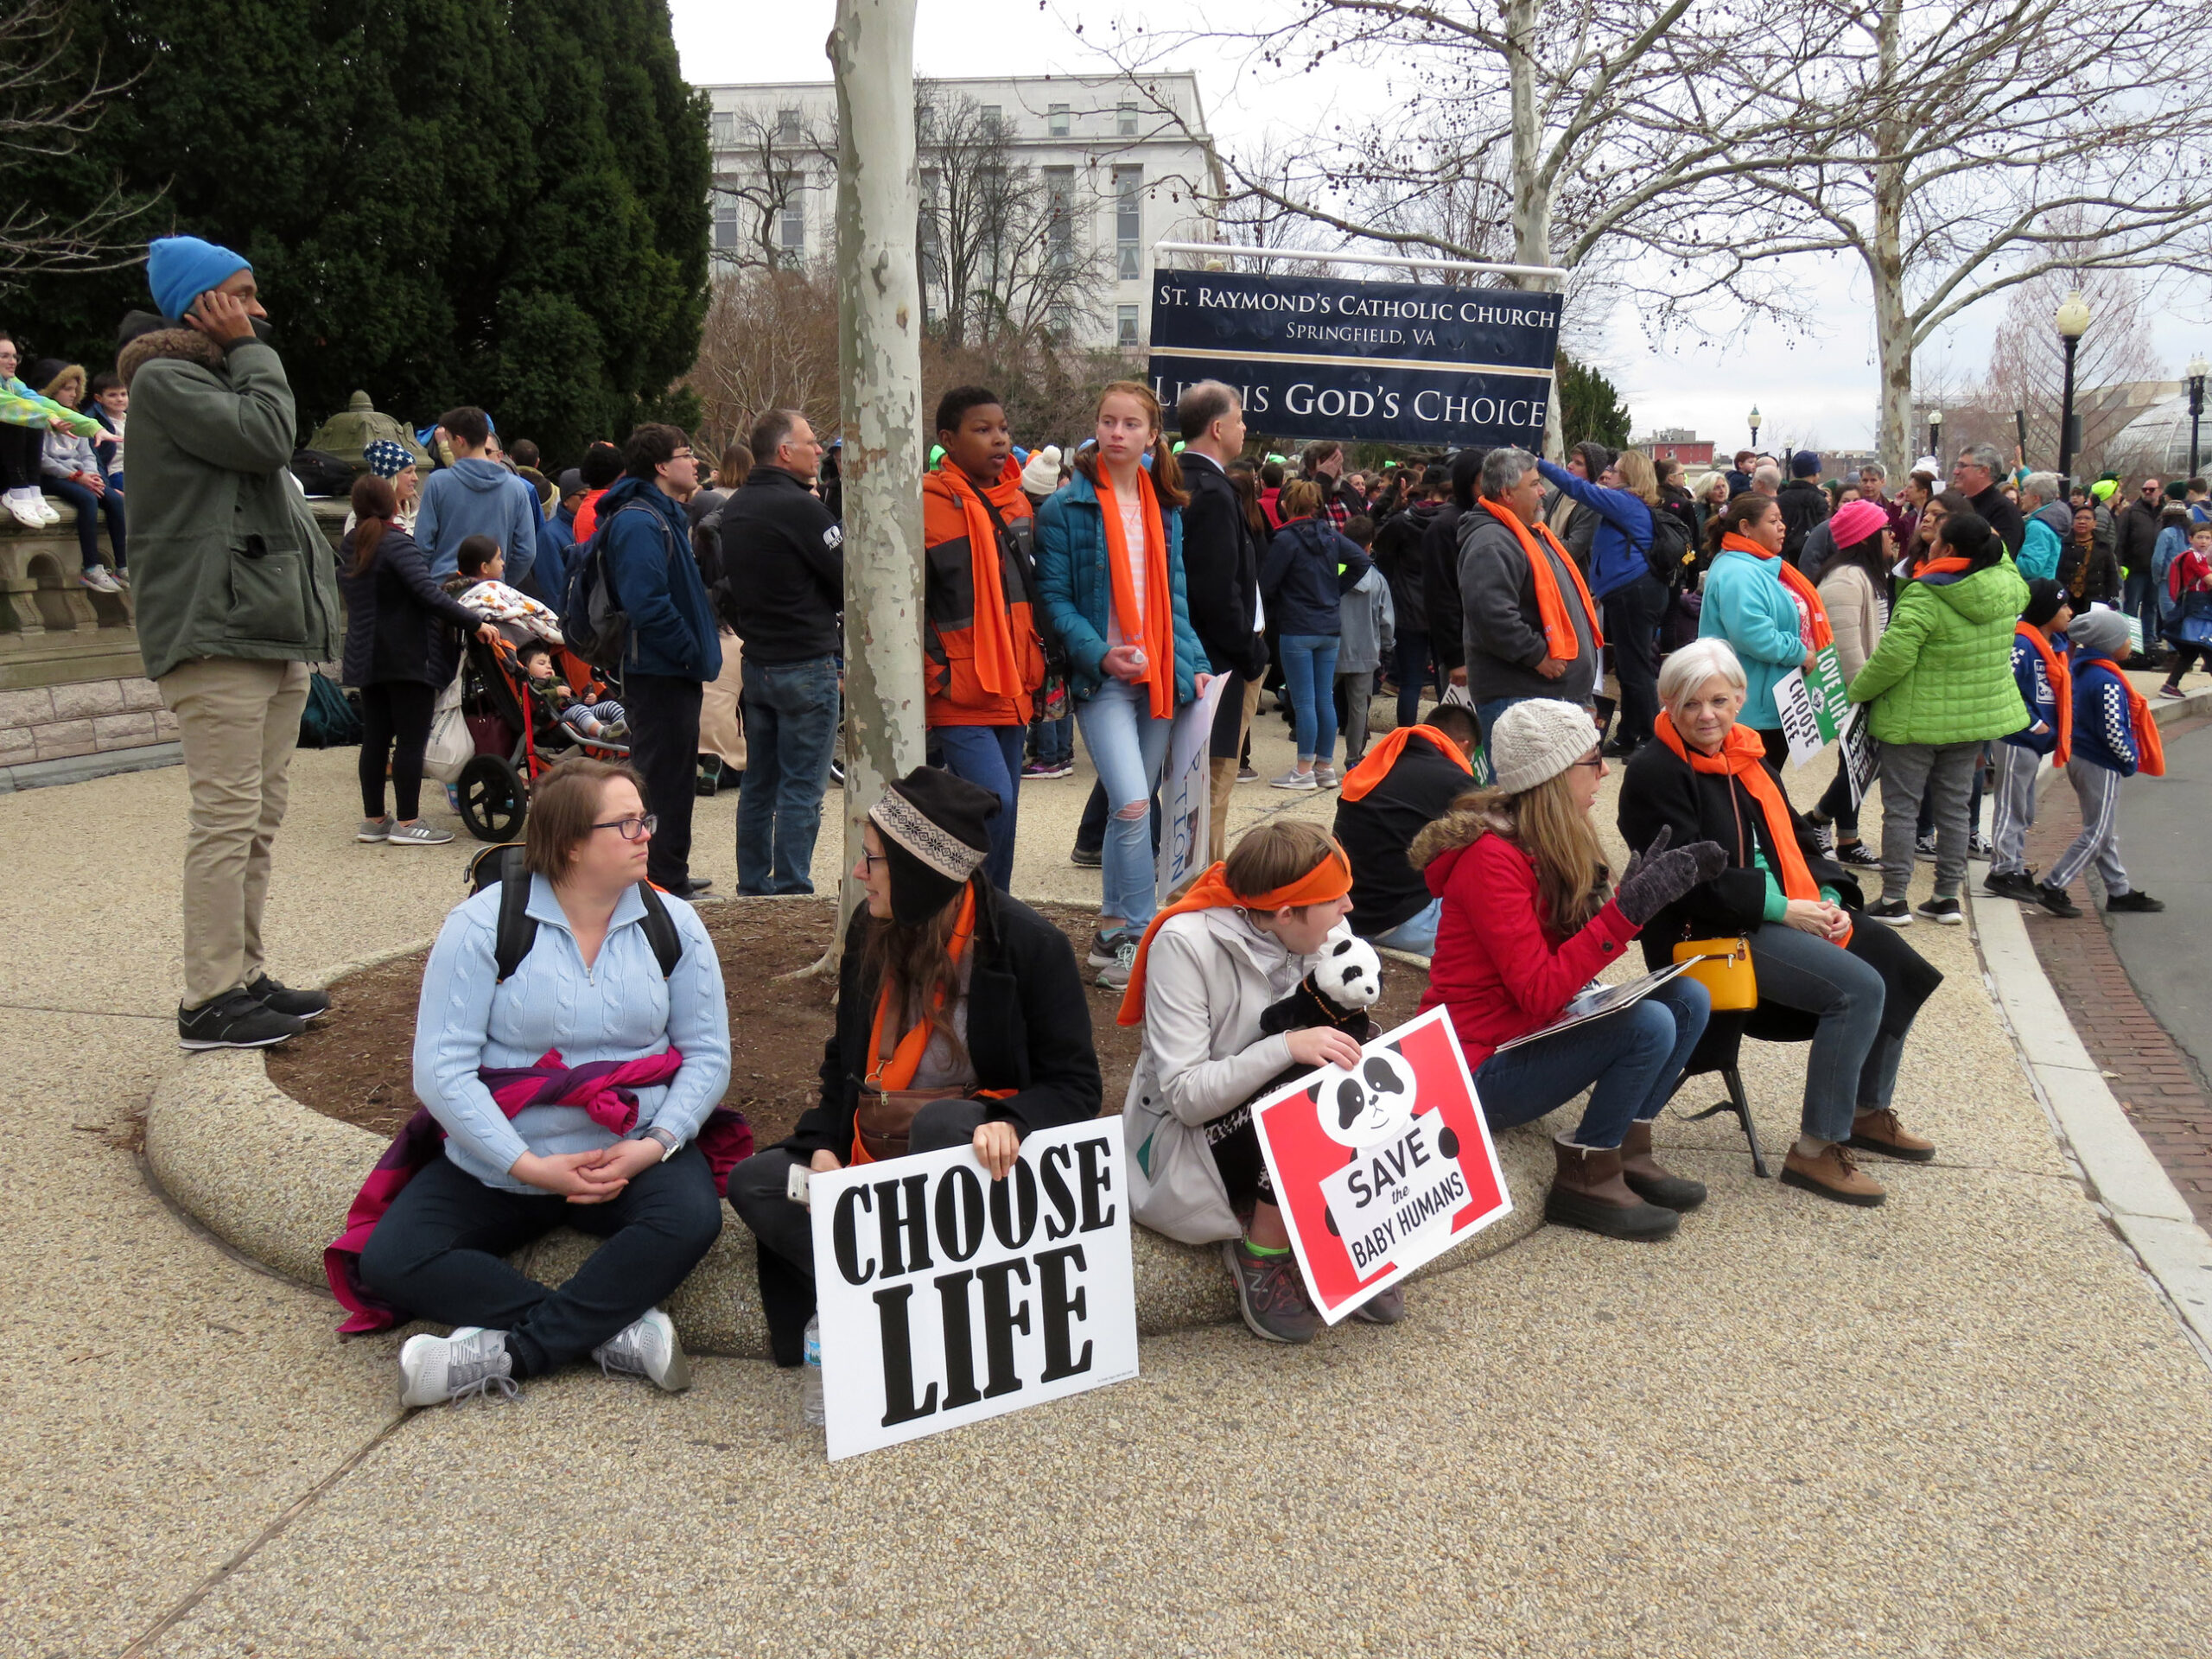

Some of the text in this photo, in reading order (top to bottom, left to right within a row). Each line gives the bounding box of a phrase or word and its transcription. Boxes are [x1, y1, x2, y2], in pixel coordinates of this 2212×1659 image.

[1160, 285, 1556, 328] ST. RAYMOND'S CATHOLIC CHURCH
[1286, 321, 1436, 346] SPRINGFIELD, VA
[1154, 376, 1546, 428] LI IS GOD'S CHOICE
[1816, 647, 1841, 693] LOVE
[1781, 705, 1800, 744] LIFE
[1789, 678, 1820, 748] CHOOSE
[1171, 781, 1187, 883] TION
[1347, 1127, 1431, 1209] SAVE
[1391, 1185, 1410, 1204] the
[833, 1136, 1116, 1286] CHOOSE
[1351, 1172, 1465, 1269] BABY HUMANS
[872, 1243, 1093, 1428] LIFE
